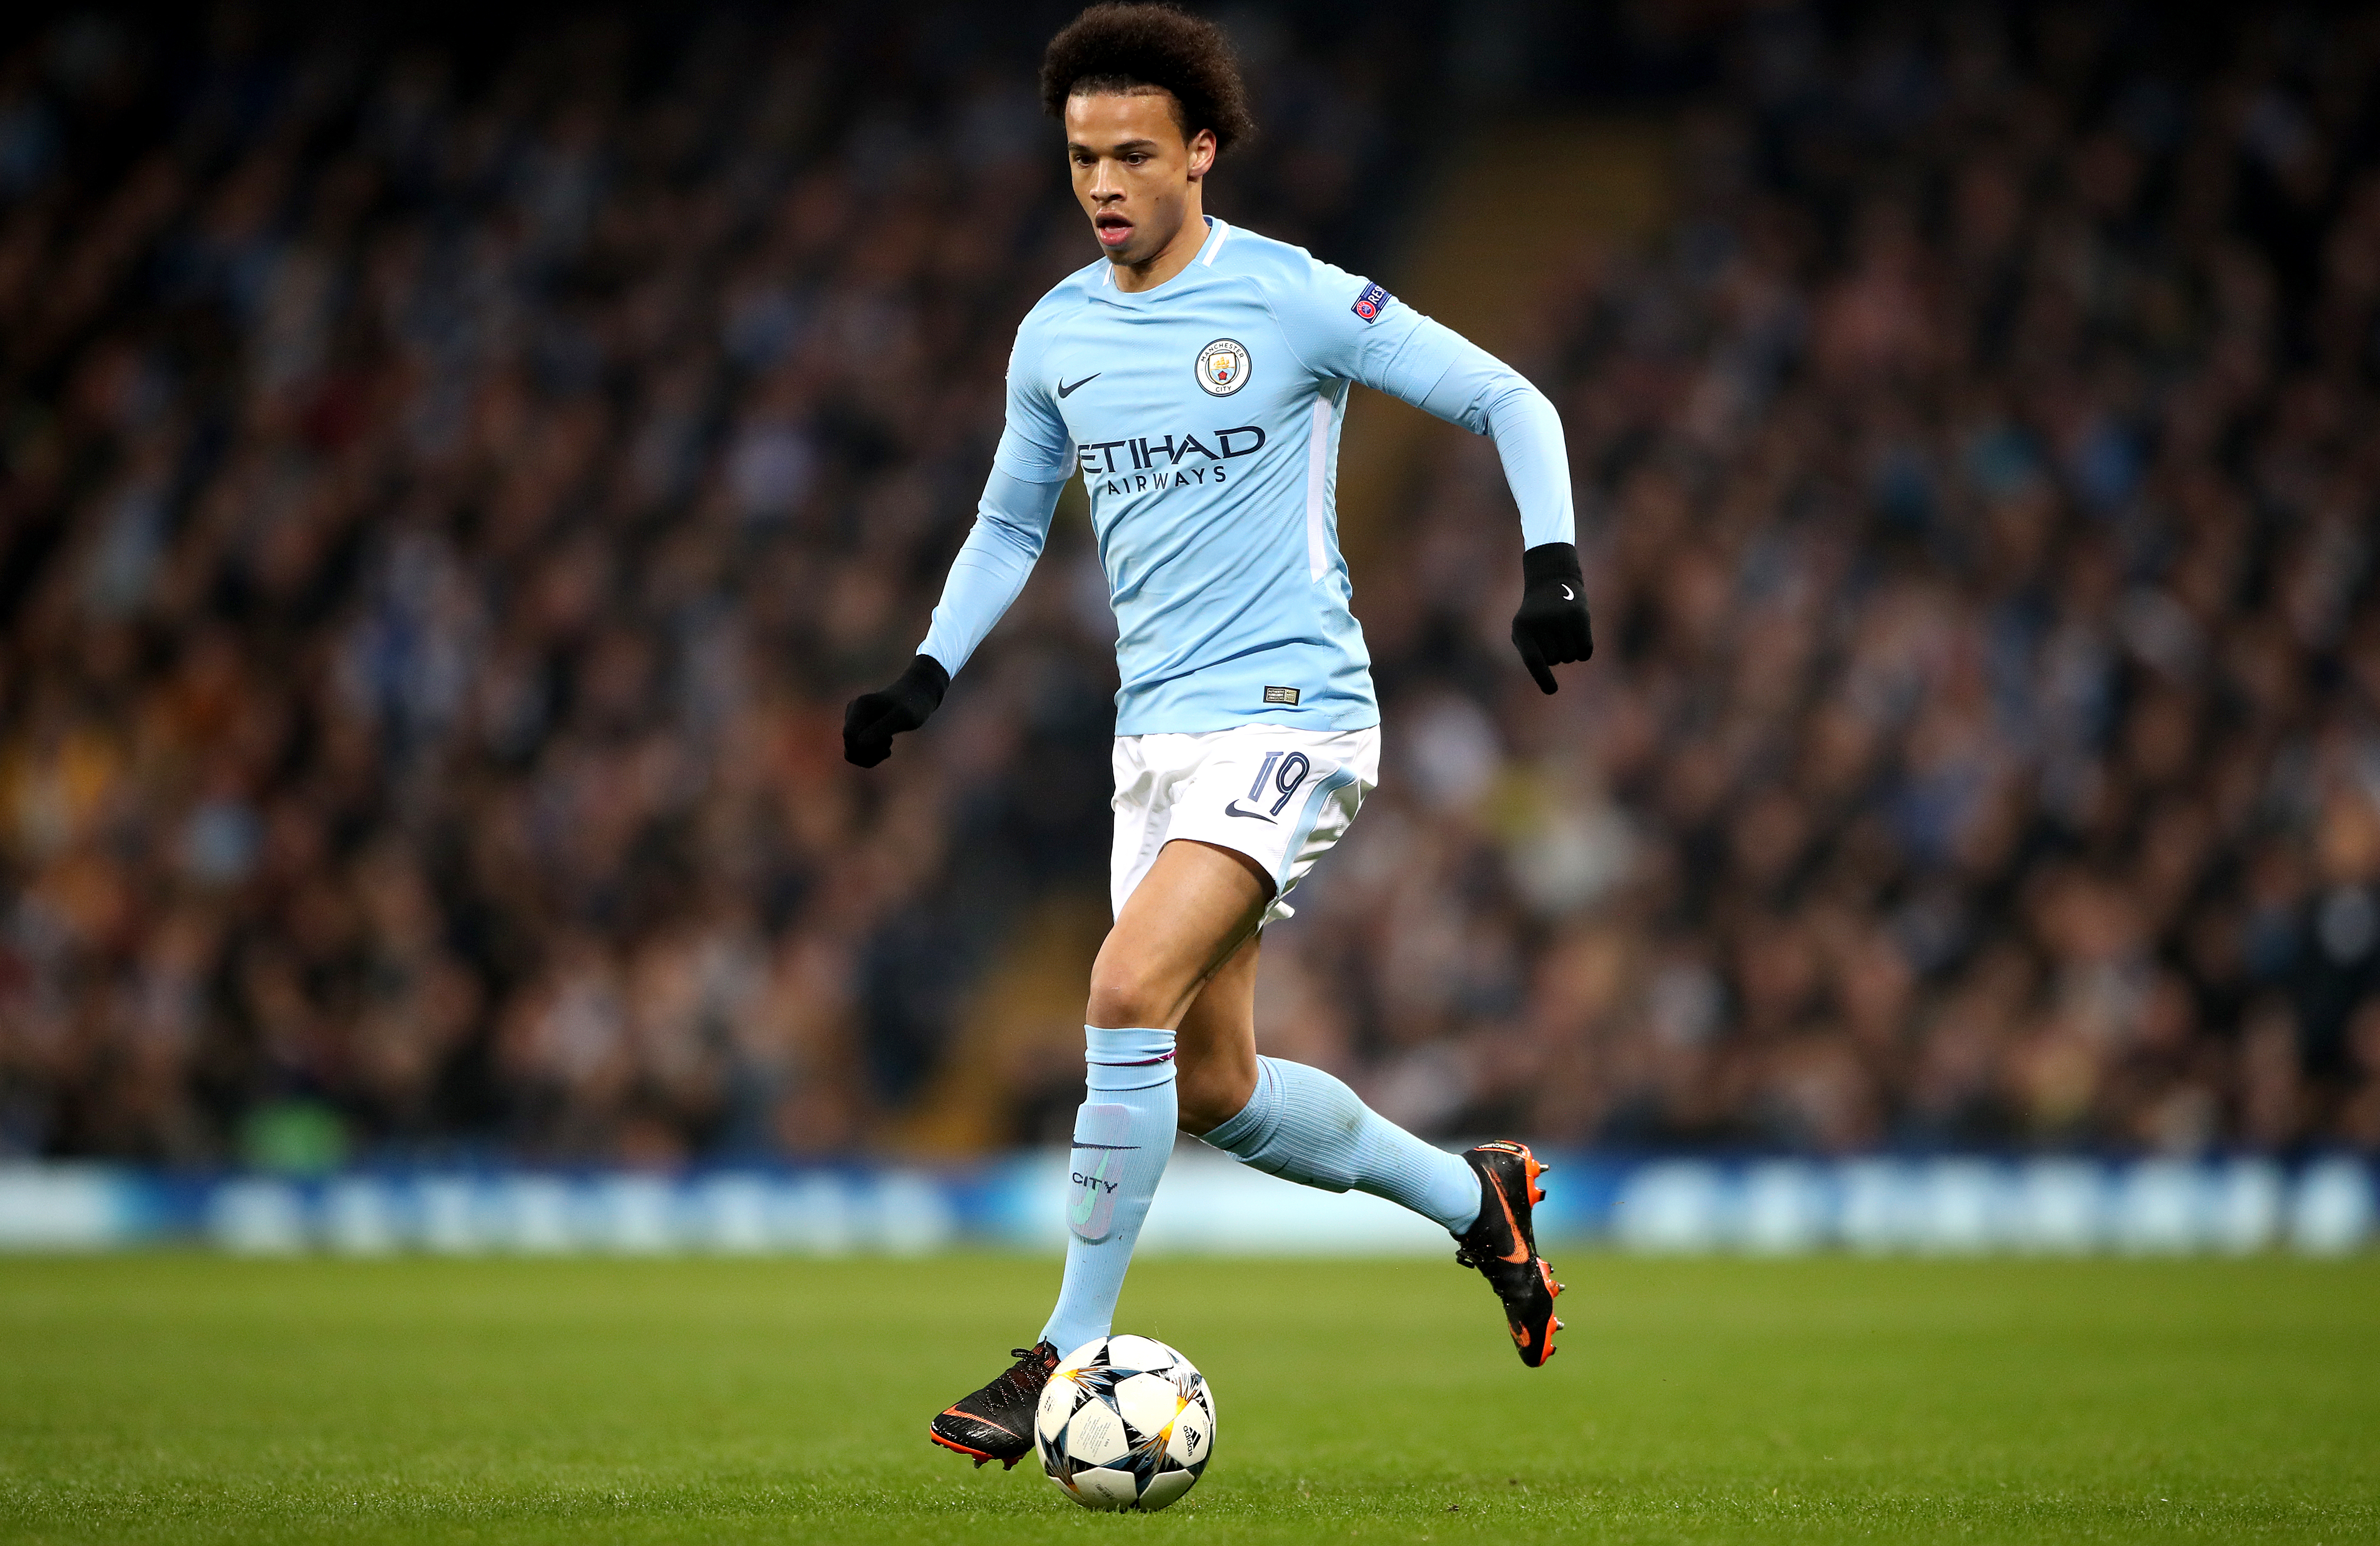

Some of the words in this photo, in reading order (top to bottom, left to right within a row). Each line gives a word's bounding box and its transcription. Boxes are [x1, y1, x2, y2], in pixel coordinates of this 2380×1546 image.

[1201, 343, 1244, 362] MANCHESTER
[1078, 426, 1266, 474] ETIHAD
[1108, 466, 1226, 495] AIRWAYS
[1247, 751, 1310, 817] 19
[1072, 1172, 1118, 1194] CITY
[1183, 1425, 1193, 1457] adidas
